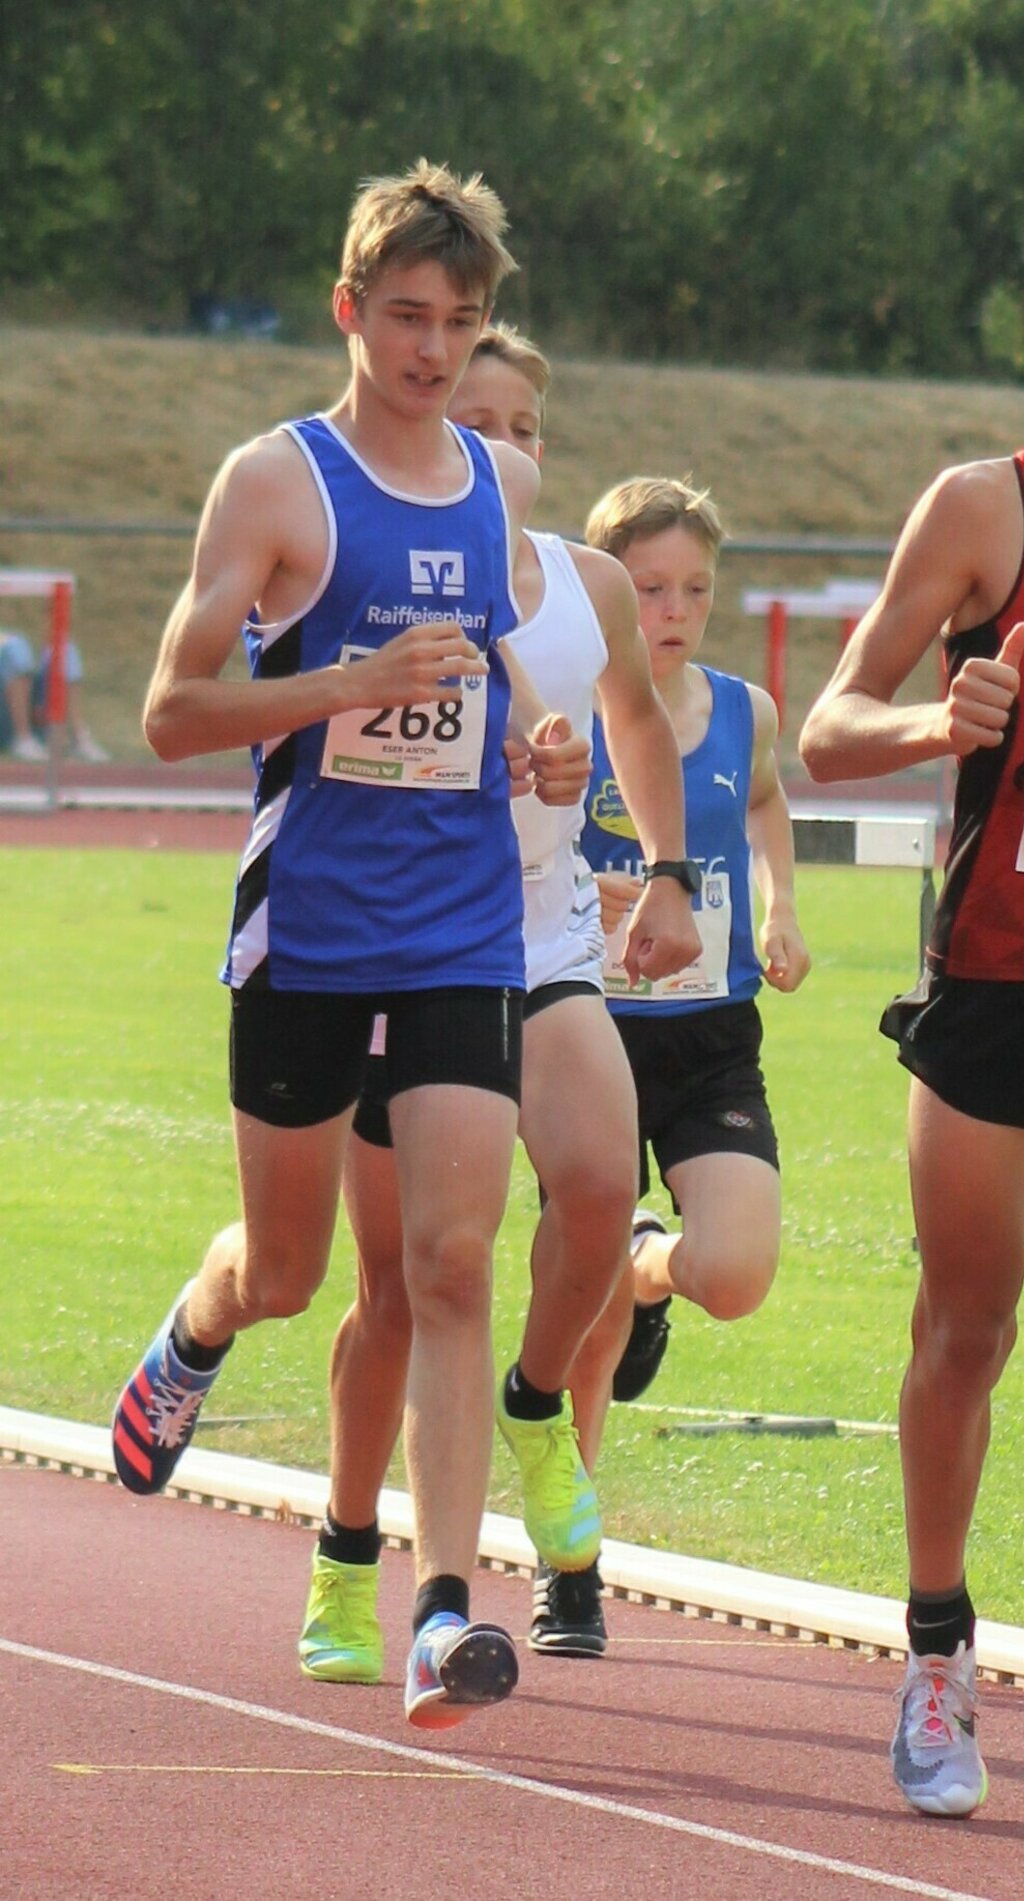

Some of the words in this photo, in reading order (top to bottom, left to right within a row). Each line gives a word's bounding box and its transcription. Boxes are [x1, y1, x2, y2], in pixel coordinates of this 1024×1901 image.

[367, 606, 488, 629] Raiffeisenban
[360, 699, 463, 742] 268
[405, 747, 438, 756] ANTON
[338, 762, 380, 777] erima
